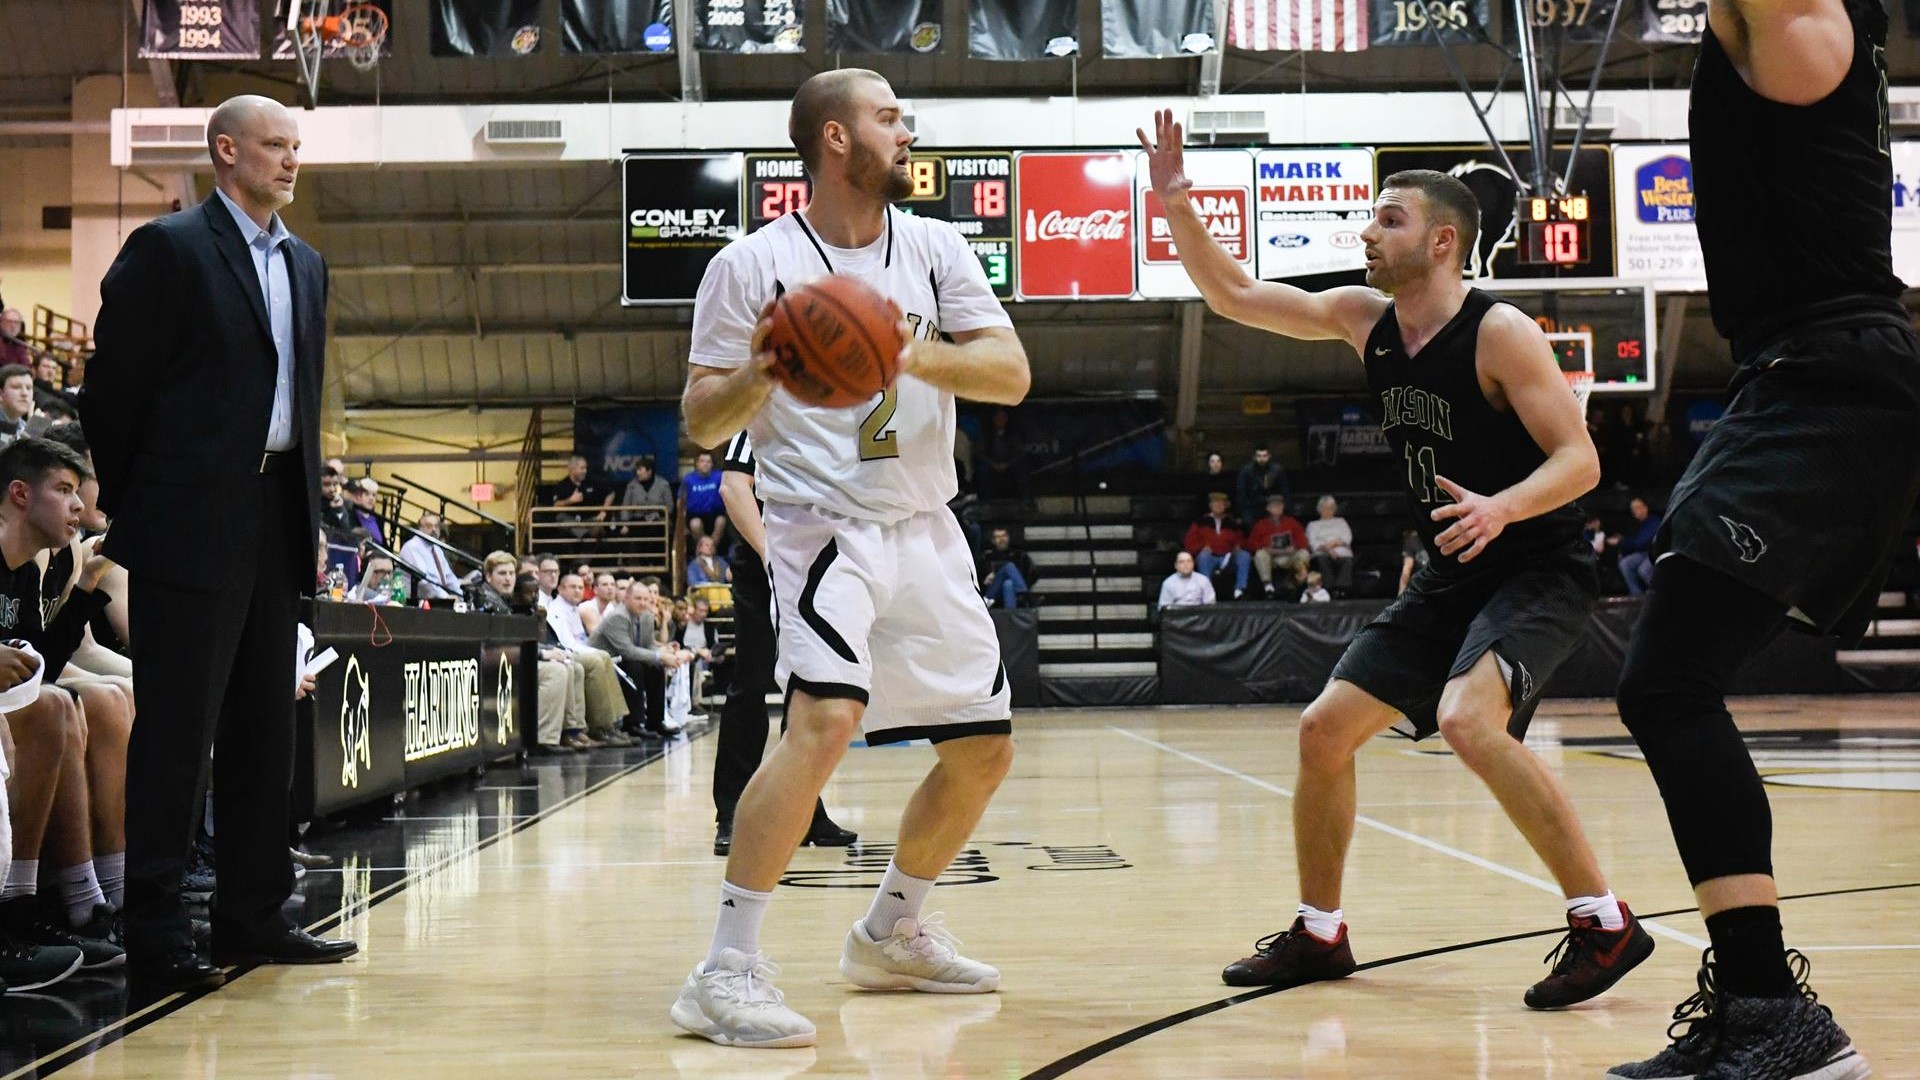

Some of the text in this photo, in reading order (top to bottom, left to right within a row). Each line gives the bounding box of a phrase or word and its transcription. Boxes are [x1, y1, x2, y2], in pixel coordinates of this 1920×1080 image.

[179, 5, 222, 26] 1993
[1660, 13, 1706, 33] 201
[178, 28, 221, 49] 1994
[755, 160, 804, 178] HOME
[945, 158, 1010, 176] VISITOR
[1260, 161, 1342, 179] MARK
[1260, 184, 1369, 202] MARTIN
[1653, 176, 1688, 192] Best
[762, 182, 808, 219] 20
[973, 181, 1006, 217] 18
[1190, 196, 1240, 216] ARM
[630, 208, 726, 227] CONLEY
[1532, 198, 1588, 221] 8:48
[659, 226, 738, 239] GRAPHICS
[951, 221, 983, 235] ONUS
[1038, 209, 1130, 241] Coca-Cola
[1334, 235, 1358, 245] KIA
[1544, 223, 1579, 262] 10
[987, 255, 1007, 285] 3
[1617, 340, 1641, 358] 05
[404, 658, 480, 763] HARDING
